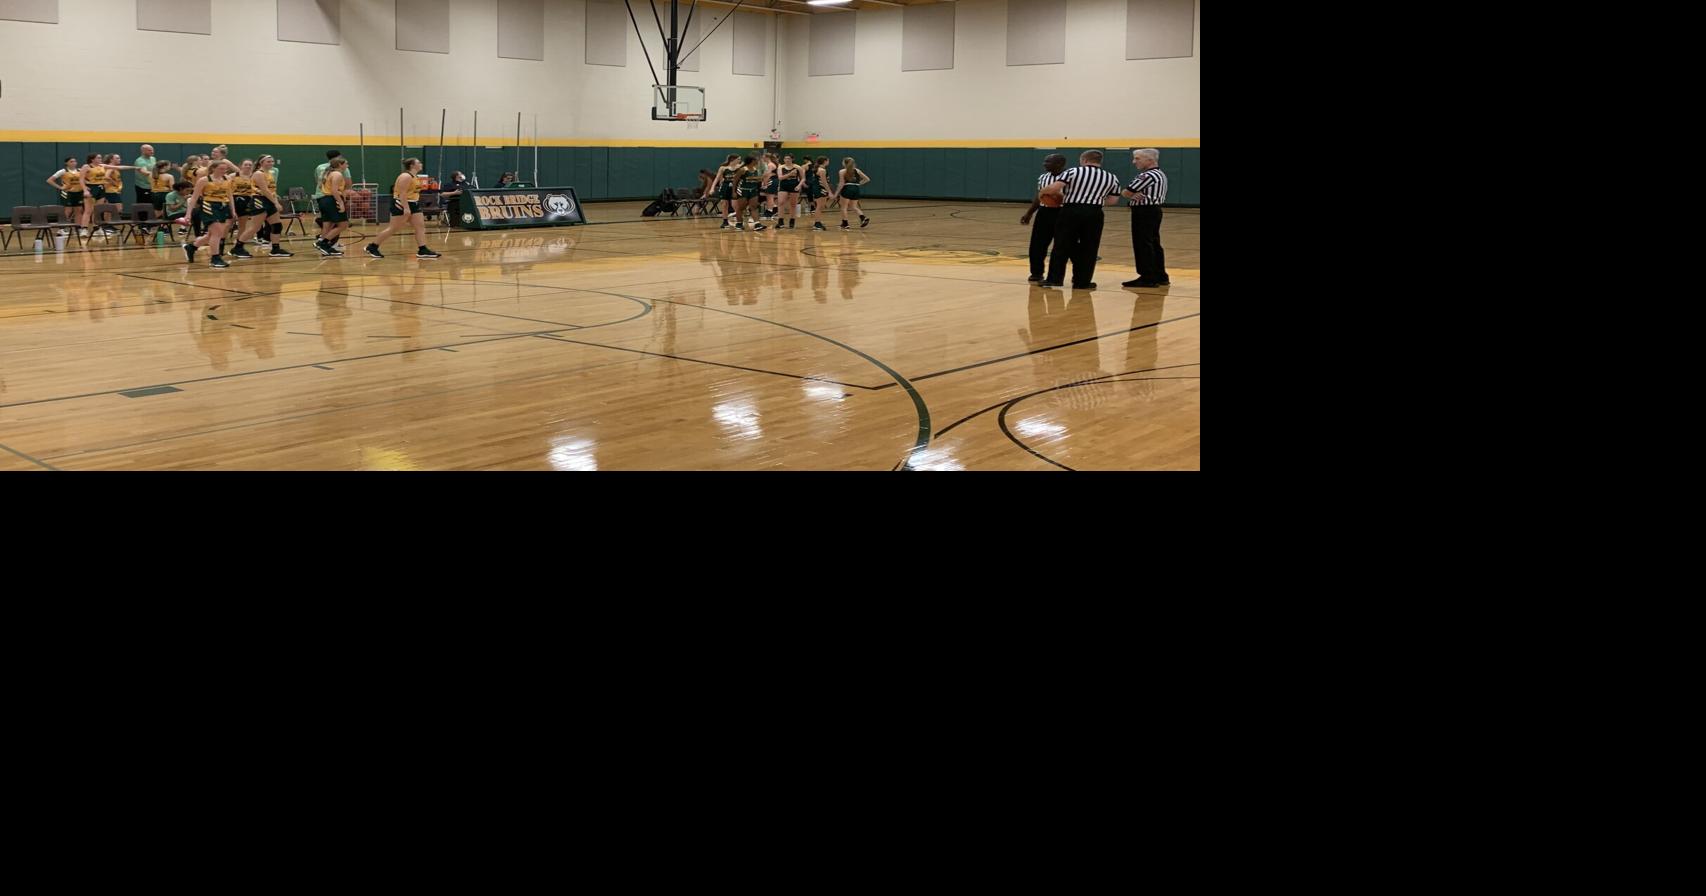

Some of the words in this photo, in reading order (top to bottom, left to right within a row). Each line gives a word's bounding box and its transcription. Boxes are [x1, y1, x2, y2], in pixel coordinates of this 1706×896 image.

[473, 195, 503, 206] ROCK
[503, 194, 541, 205] BRIDGE
[477, 205, 544, 220] BRUINS
